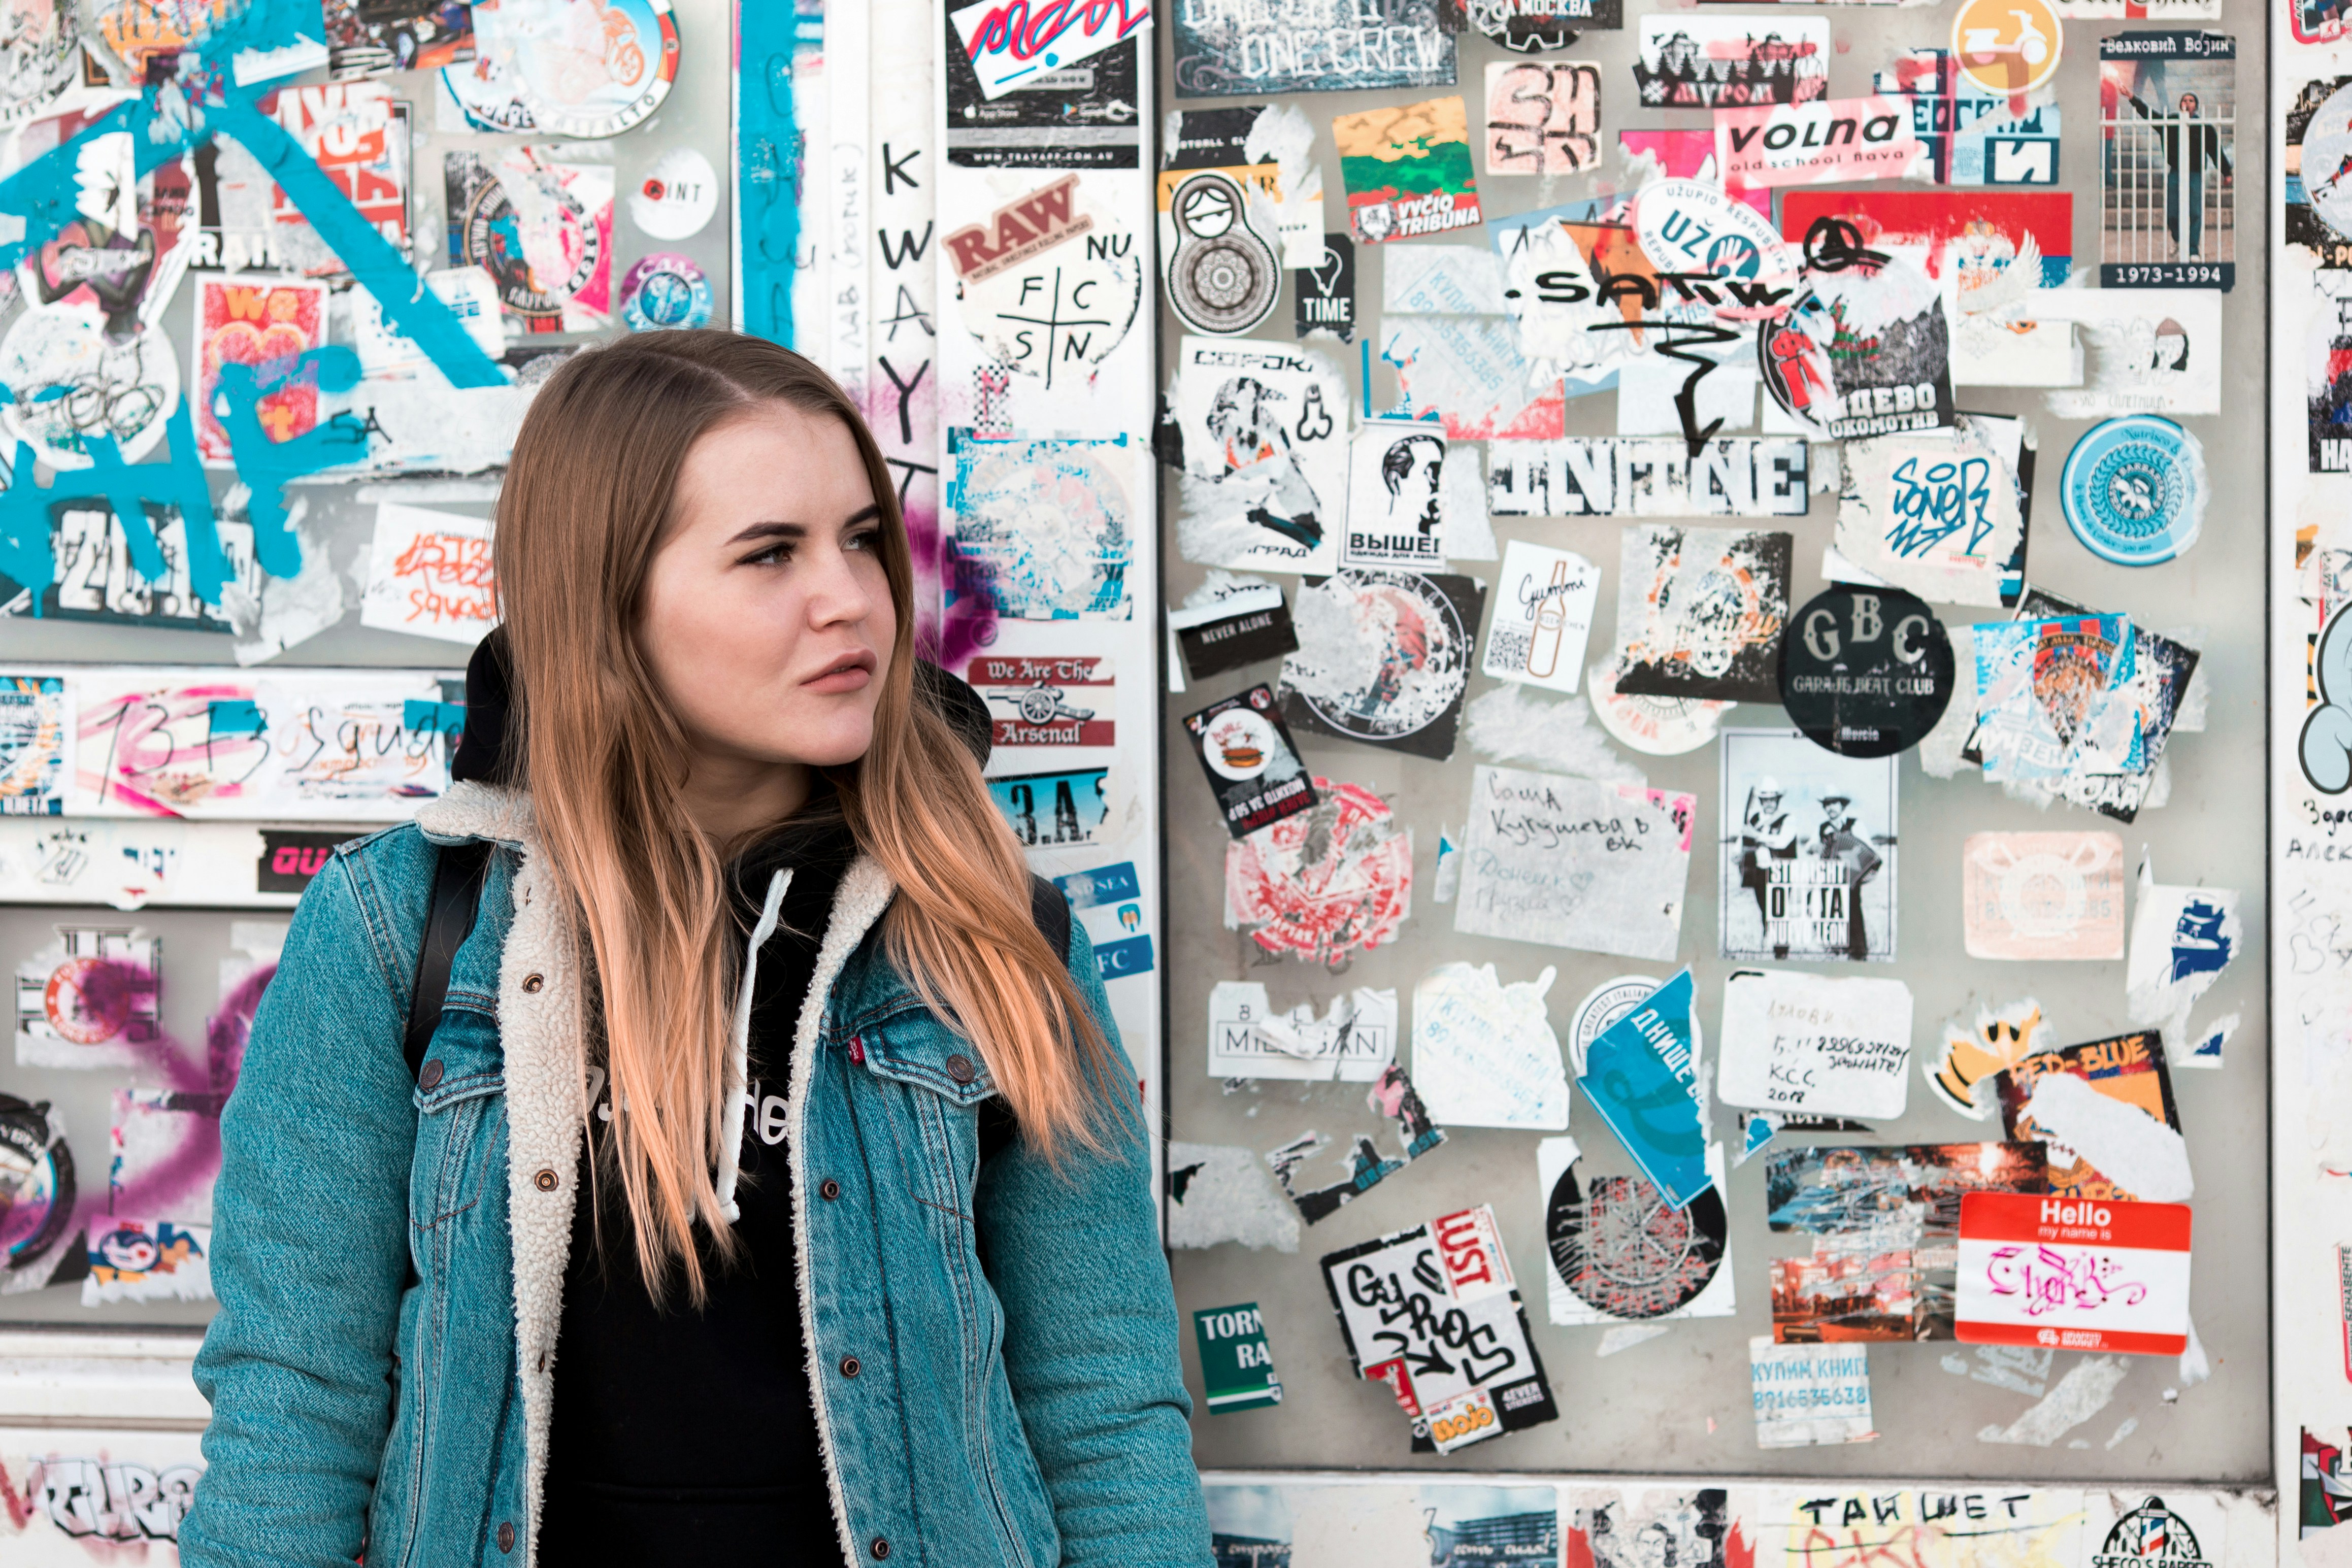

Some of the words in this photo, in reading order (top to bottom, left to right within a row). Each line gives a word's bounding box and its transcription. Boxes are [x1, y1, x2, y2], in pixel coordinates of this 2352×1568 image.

[1731, 159, 1763, 172] old
[1771, 153, 1841, 169] school
[948, 181, 1073, 276] RAW
[1661, 209, 1714, 259] UŽ
[2115, 266, 2223, 284] 1973-1994
[1303, 297, 1351, 323] TIME
[1201, 623, 1237, 645] NEVER
[1238, 612, 1273, 633] ALONE
[986, 661, 1015, 680] We
[1017, 660, 1052, 680] Are
[1054, 660, 1094, 681] The
[1895, 677, 1935, 696] CLUB
[1000, 720, 1085, 744] Arsenal
[2039, 1198, 2112, 1227] Hello
[2037, 1225, 2059, 1240] my
[2060, 1227, 2097, 1240] name
[2100, 1226, 2112, 1240] is
[1751, 1359, 1812, 1382] КУПИМ
